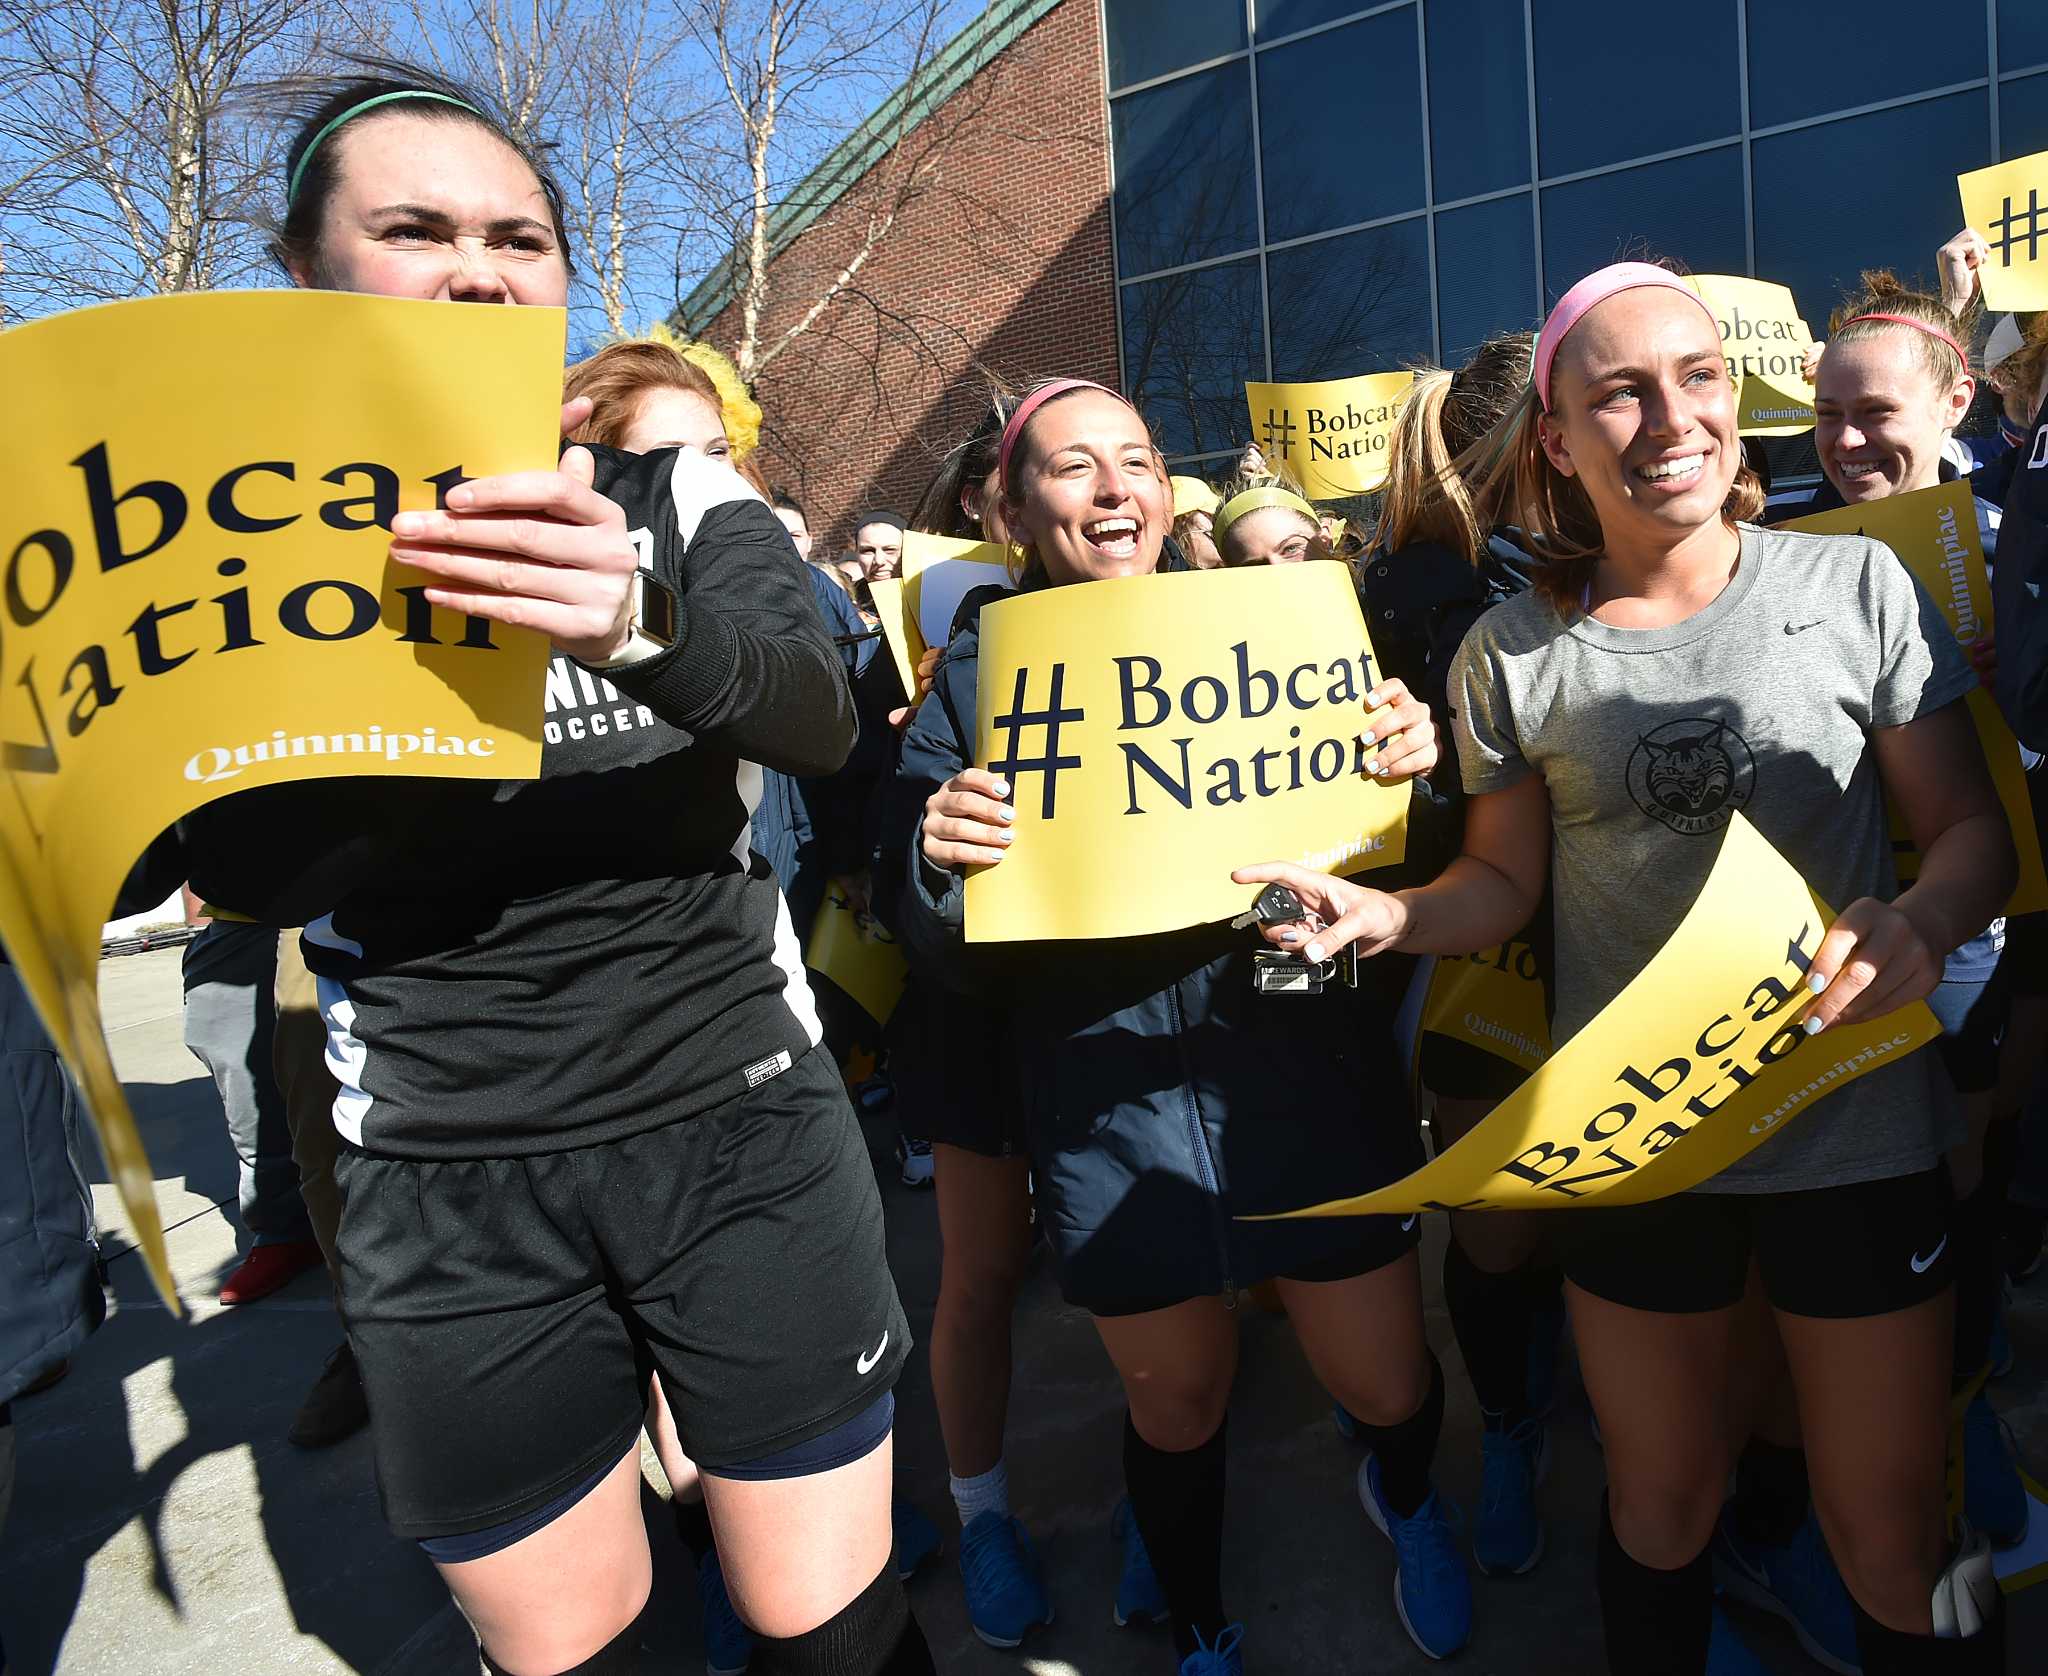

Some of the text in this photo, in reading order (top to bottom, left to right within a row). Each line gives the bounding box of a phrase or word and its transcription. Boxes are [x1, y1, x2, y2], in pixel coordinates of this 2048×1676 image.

[1717, 306, 1799, 342] obcat
[1724, 346, 1805, 378] ation
[1308, 430, 1391, 462] Natio
[0, 440, 482, 628] obcat
[1935, 505, 1983, 646] Quinnipiac
[1112, 640, 1374, 731] Bobcat
[184, 725, 496, 785] Quinnipiac
[544, 704, 655, 745] OCCER
[1646, 789, 1745, 832] QUINNIPIC
[1494, 920, 1814, 1190] Bobcat
[1748, 1030, 1913, 1136] Quinnipiac
[1543, 1020, 1804, 1200] Natio
